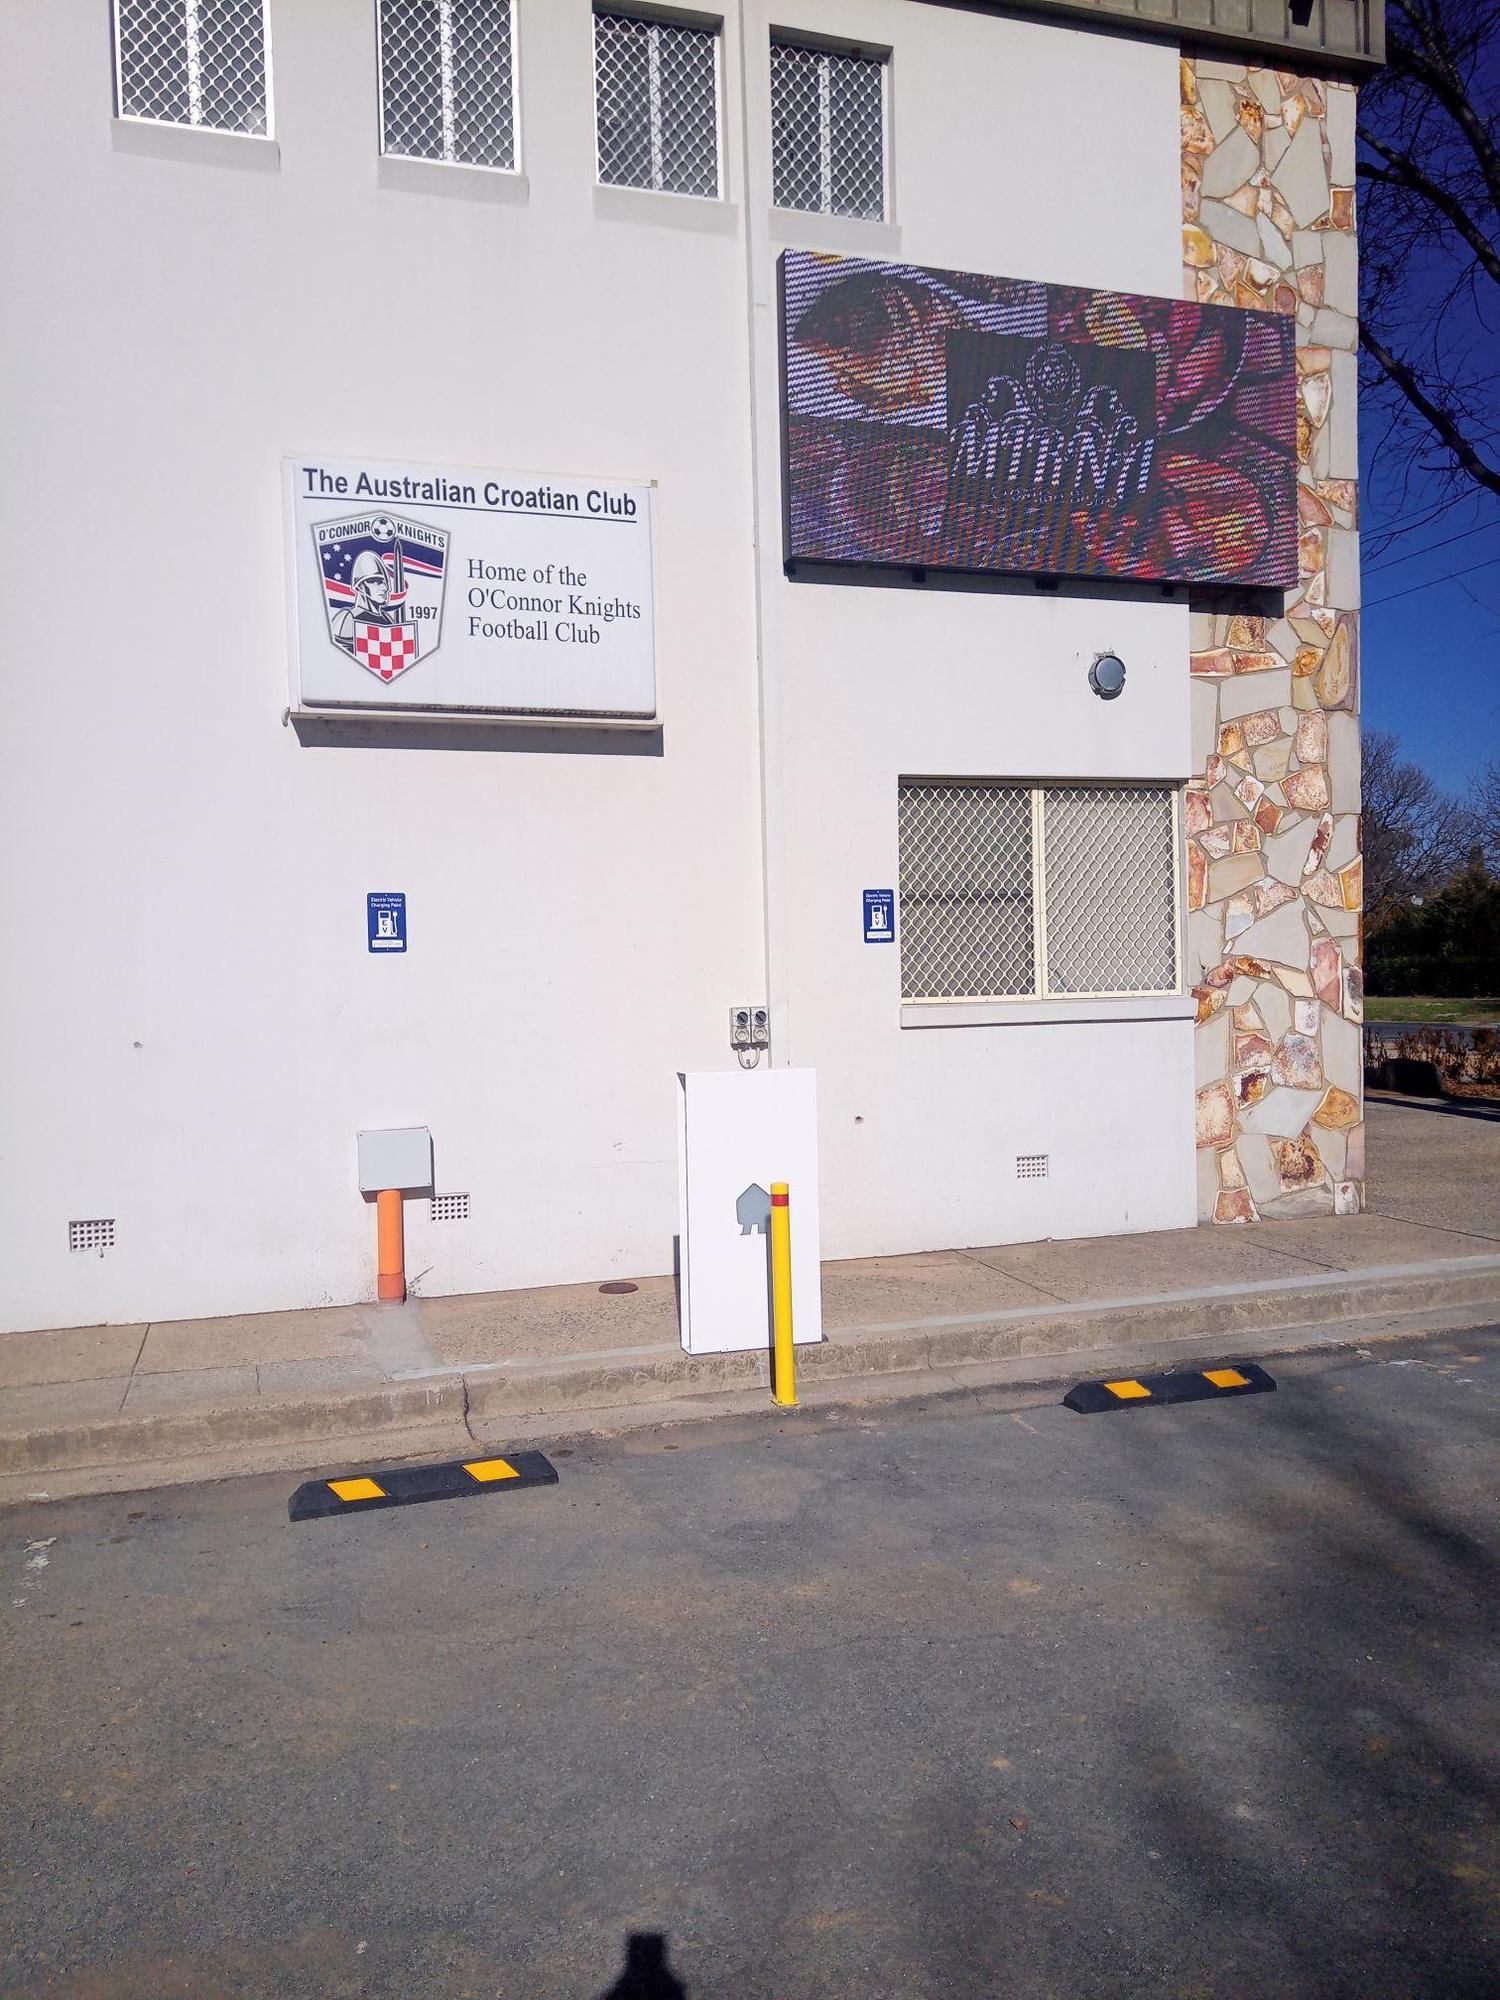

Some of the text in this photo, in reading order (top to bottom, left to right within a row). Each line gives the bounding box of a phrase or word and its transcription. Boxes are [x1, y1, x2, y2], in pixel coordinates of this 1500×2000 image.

[302, 467, 637, 517] The Australian Croatian Club
[319, 520, 445, 549] O'CONNOR KNIGHTS
[467, 558, 587, 587] Home of the
[409, 606, 438, 620] 1997
[467, 587, 642, 623] O'Connor Knights
[468, 616, 601, 645] Football Club
